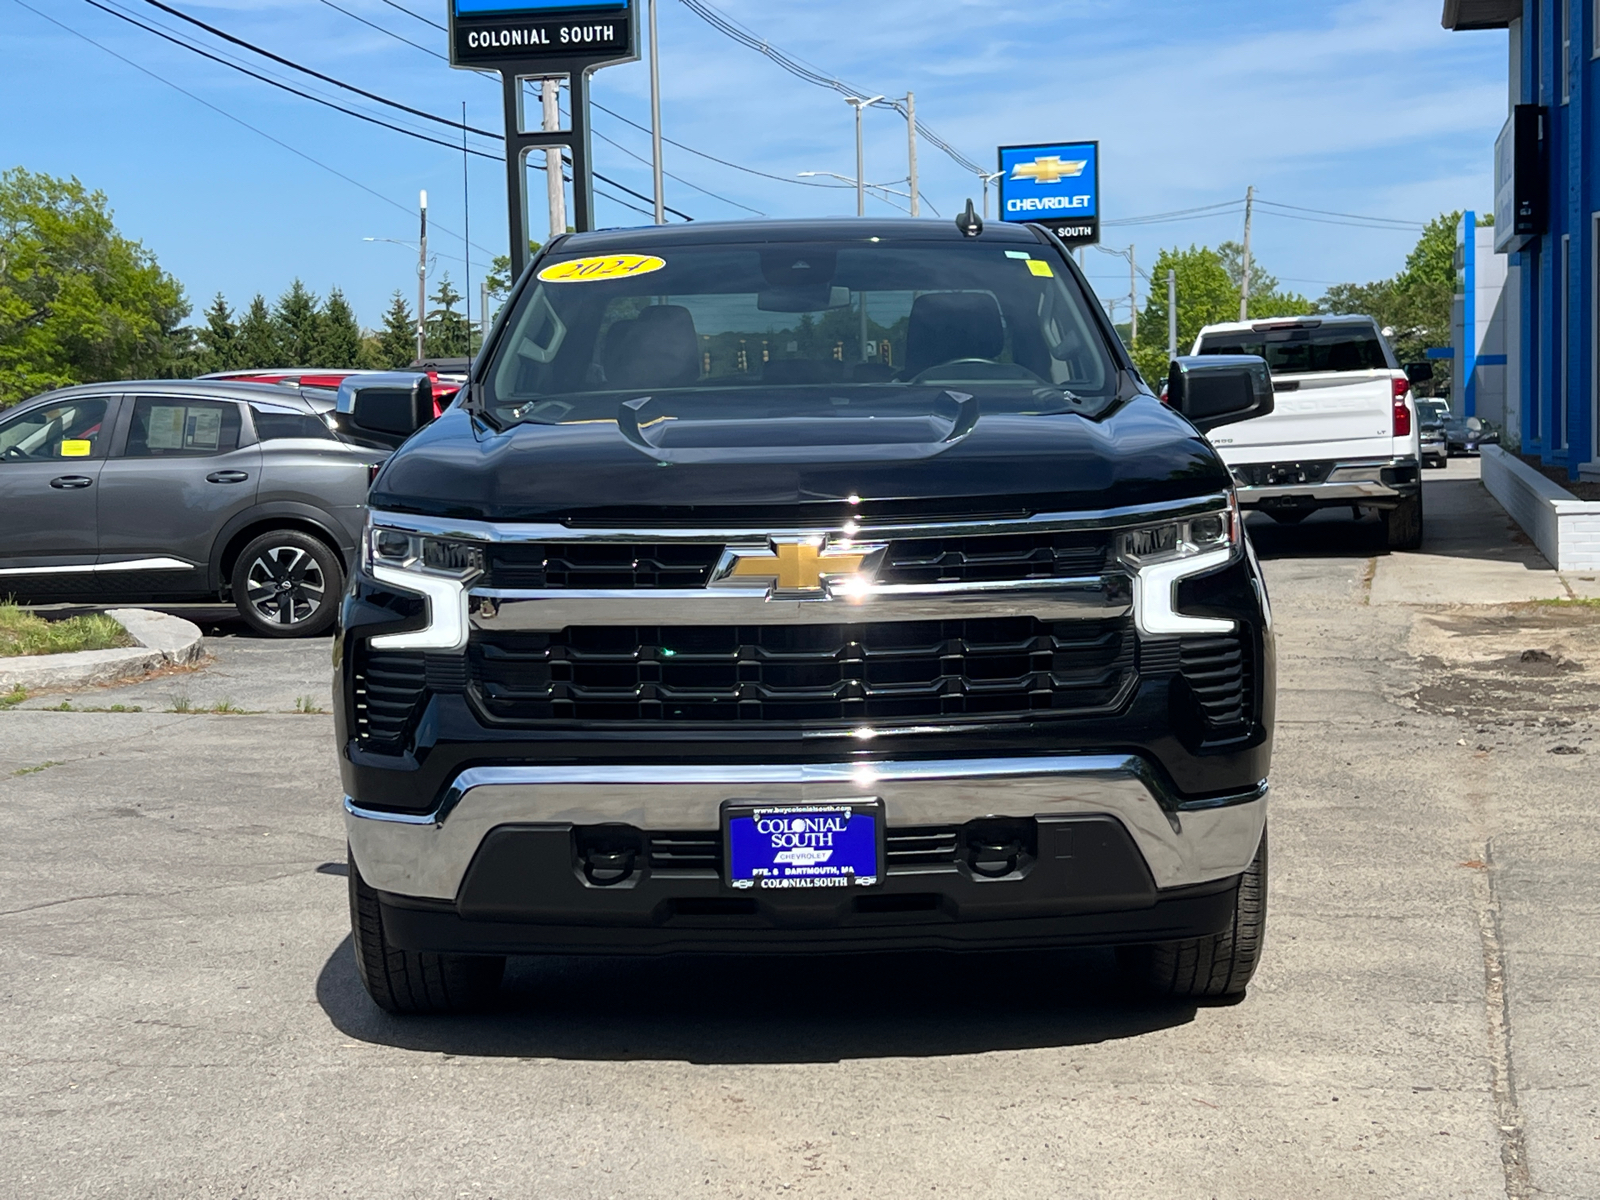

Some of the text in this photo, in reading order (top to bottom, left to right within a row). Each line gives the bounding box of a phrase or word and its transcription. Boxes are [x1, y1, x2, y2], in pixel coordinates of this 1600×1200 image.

[468, 25, 614, 48] COLONIAL SOUTH
[1007, 195, 1091, 212] CHEVROLET
[1057, 226, 1092, 237] SOUTH
[555, 258, 650, 279] 2024
[757, 817, 848, 834] COLONIAL
[771, 832, 834, 848] SOUTH
[780, 852, 827, 860] CHEVROLET
[784, 866, 840, 876] DARTMOUTH,
[761, 876, 848, 889] COLONIAL SOUTH
